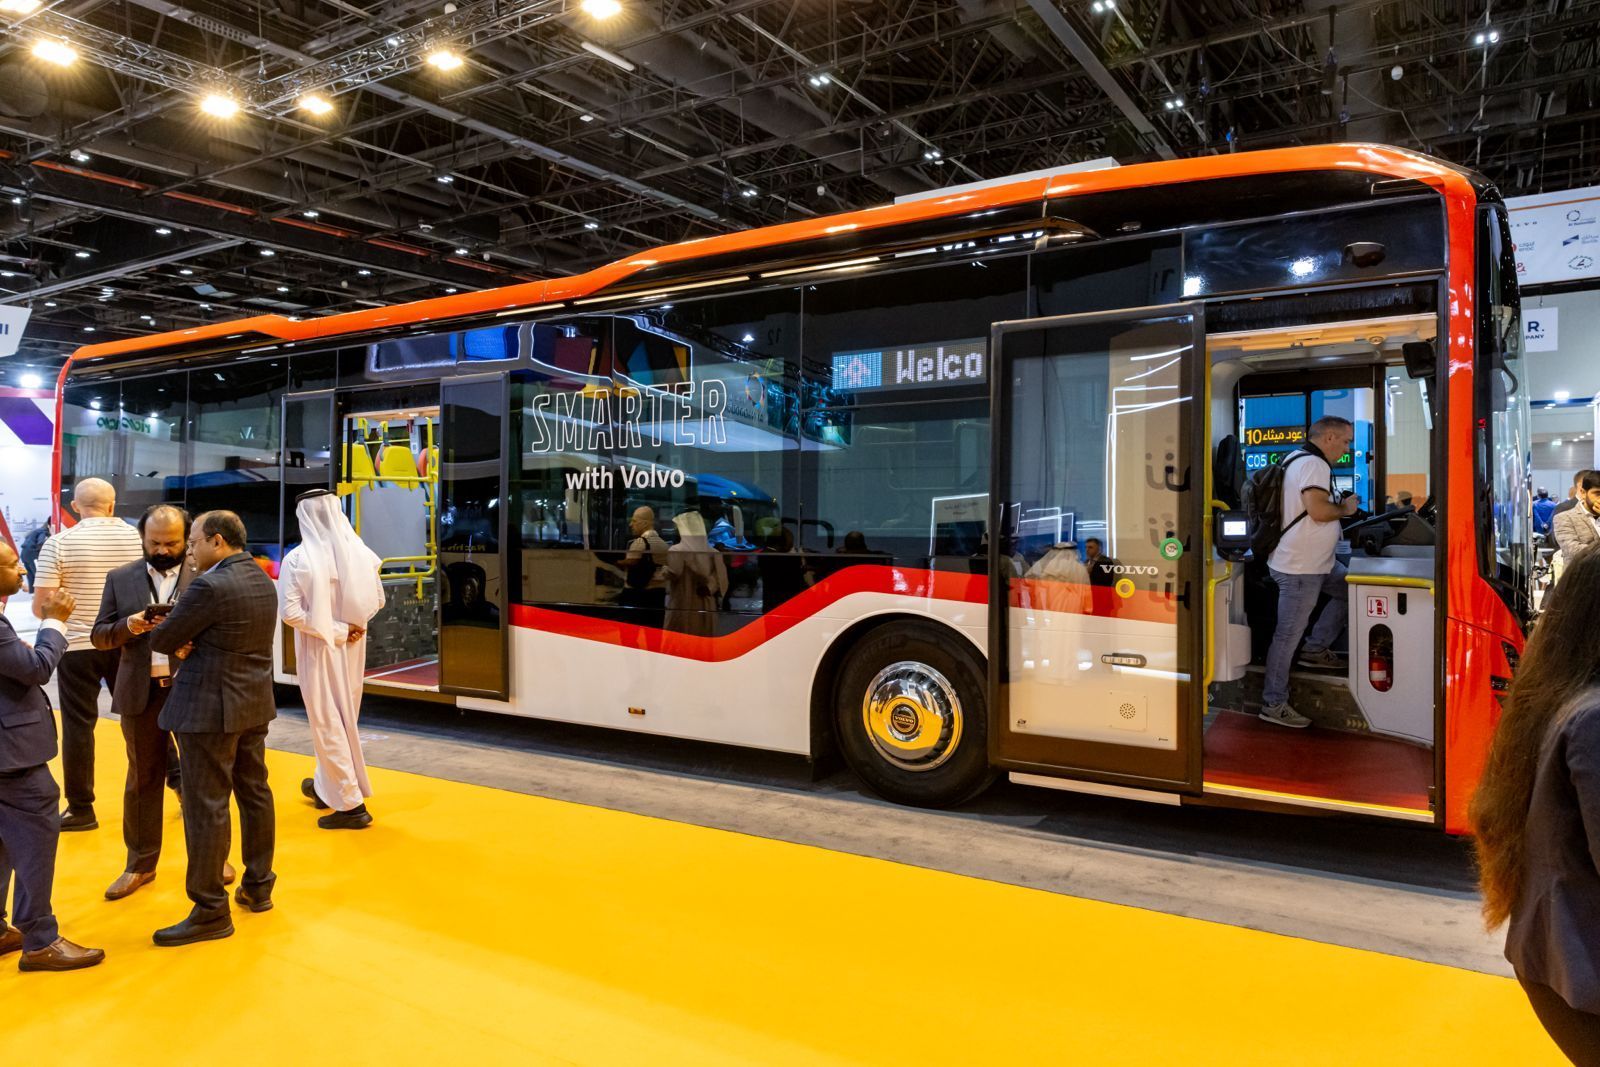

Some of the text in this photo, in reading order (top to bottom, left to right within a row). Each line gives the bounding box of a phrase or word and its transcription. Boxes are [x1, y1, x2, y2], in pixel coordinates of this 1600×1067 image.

[896, 347, 983, 384] Welco
[531, 379, 727, 453] SMARTER
[1246, 428, 1263, 445] 10
[565, 463, 686, 490] with Volvo
[1099, 564, 1159, 576] VOLVO
[894, 715, 914, 724] VOLVO
